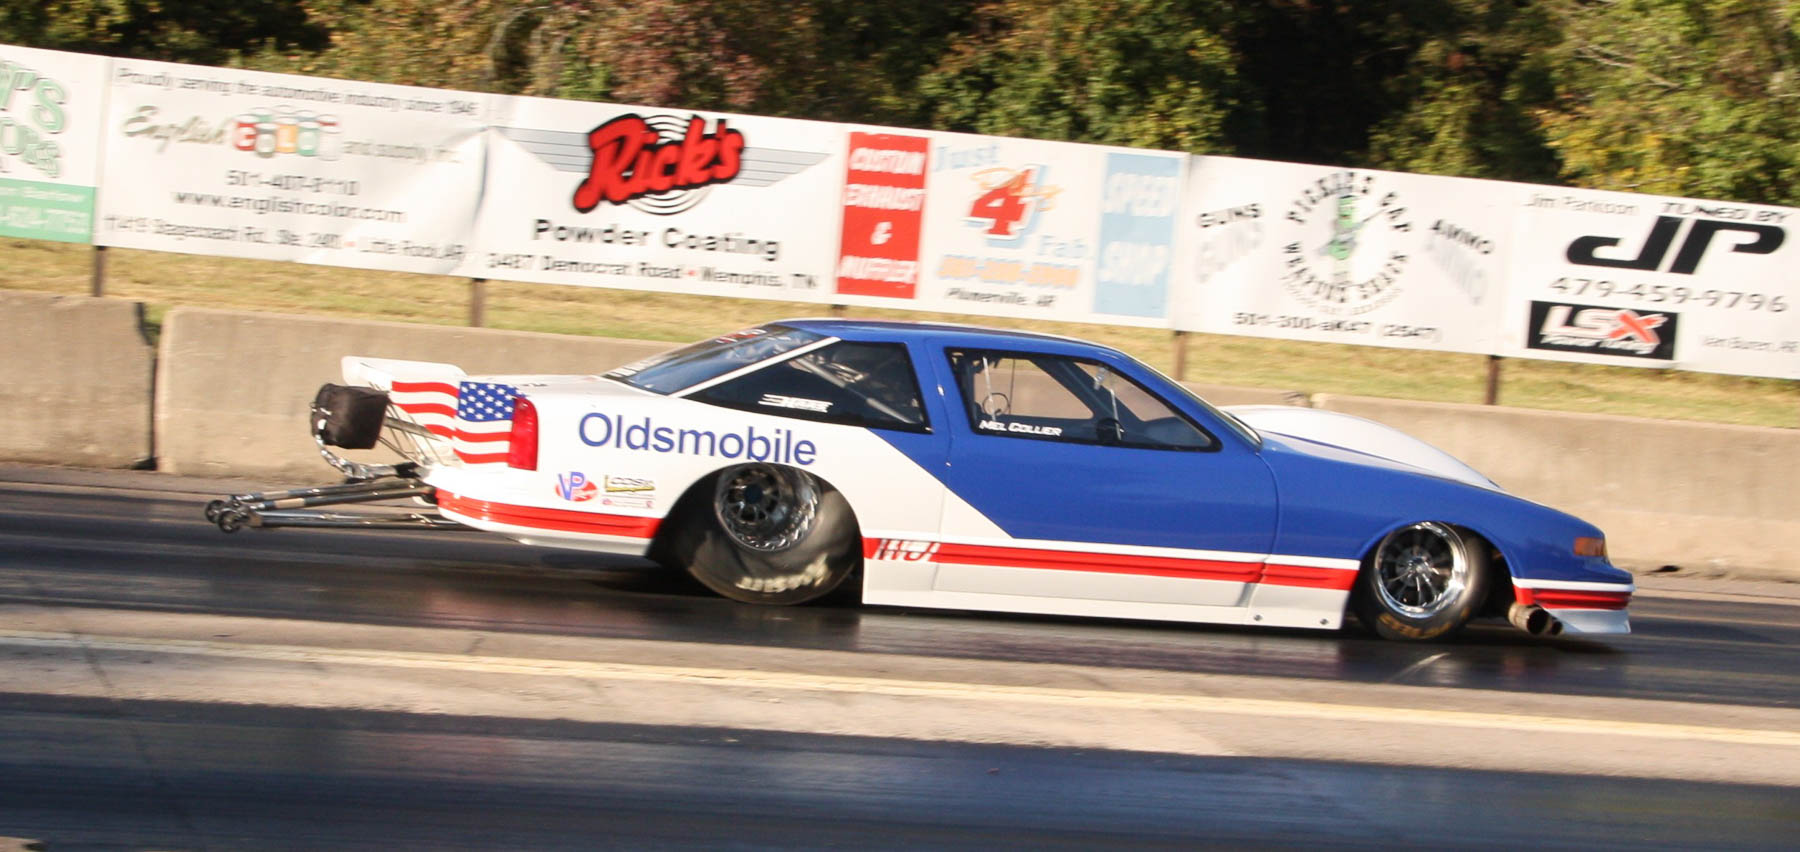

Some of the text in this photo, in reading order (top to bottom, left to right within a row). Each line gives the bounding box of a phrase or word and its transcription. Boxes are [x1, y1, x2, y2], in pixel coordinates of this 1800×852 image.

[118, 67, 172, 91] Proudly
[178, 77, 232, 97] serving
[235, 80, 259, 95] the
[263, 85, 342, 104] automotive
[345, 93, 400, 112] industry
[404, 96, 442, 113] since
[123, 105, 232, 152] English
[344, 141, 371, 155] and
[572, 112, 745, 213] Rick's
[849, 147, 925, 175] CUSTOM
[932, 144, 1000, 174] Just
[227, 169, 360, 196] 501-407-8110
[843, 183, 926, 211] EXHAUST
[1103, 172, 1177, 217] SPEED
[173, 191, 406, 222] www.englishcolor.com
[964, 164, 1043, 243] 4
[1196, 202, 1262, 228] GUNS
[1523, 193, 1556, 208] Jim
[1662, 202, 1791, 223] TUNED BY
[153, 218, 238, 241] Stagecoach
[360, 236, 398, 254] Little
[441, 243, 465, 260] AR
[533, 218, 781, 261] Powder Coating
[870, 221, 892, 245] &
[1036, 234, 1086, 259] Fab
[1429, 218, 1495, 255] AMMO
[541, 254, 631, 276] Democrat
[637, 261, 681, 279] Road
[837, 255, 918, 284] MUFFLER
[1099, 241, 1169, 286] SHOP
[1550, 276, 1788, 313] 479-459-9796
[1540, 305, 1668, 345] LSX
[578, 412, 817, 465] Oldsmobile
[979, 420, 1007, 431] MEL
[558, 471, 585, 501] VP
